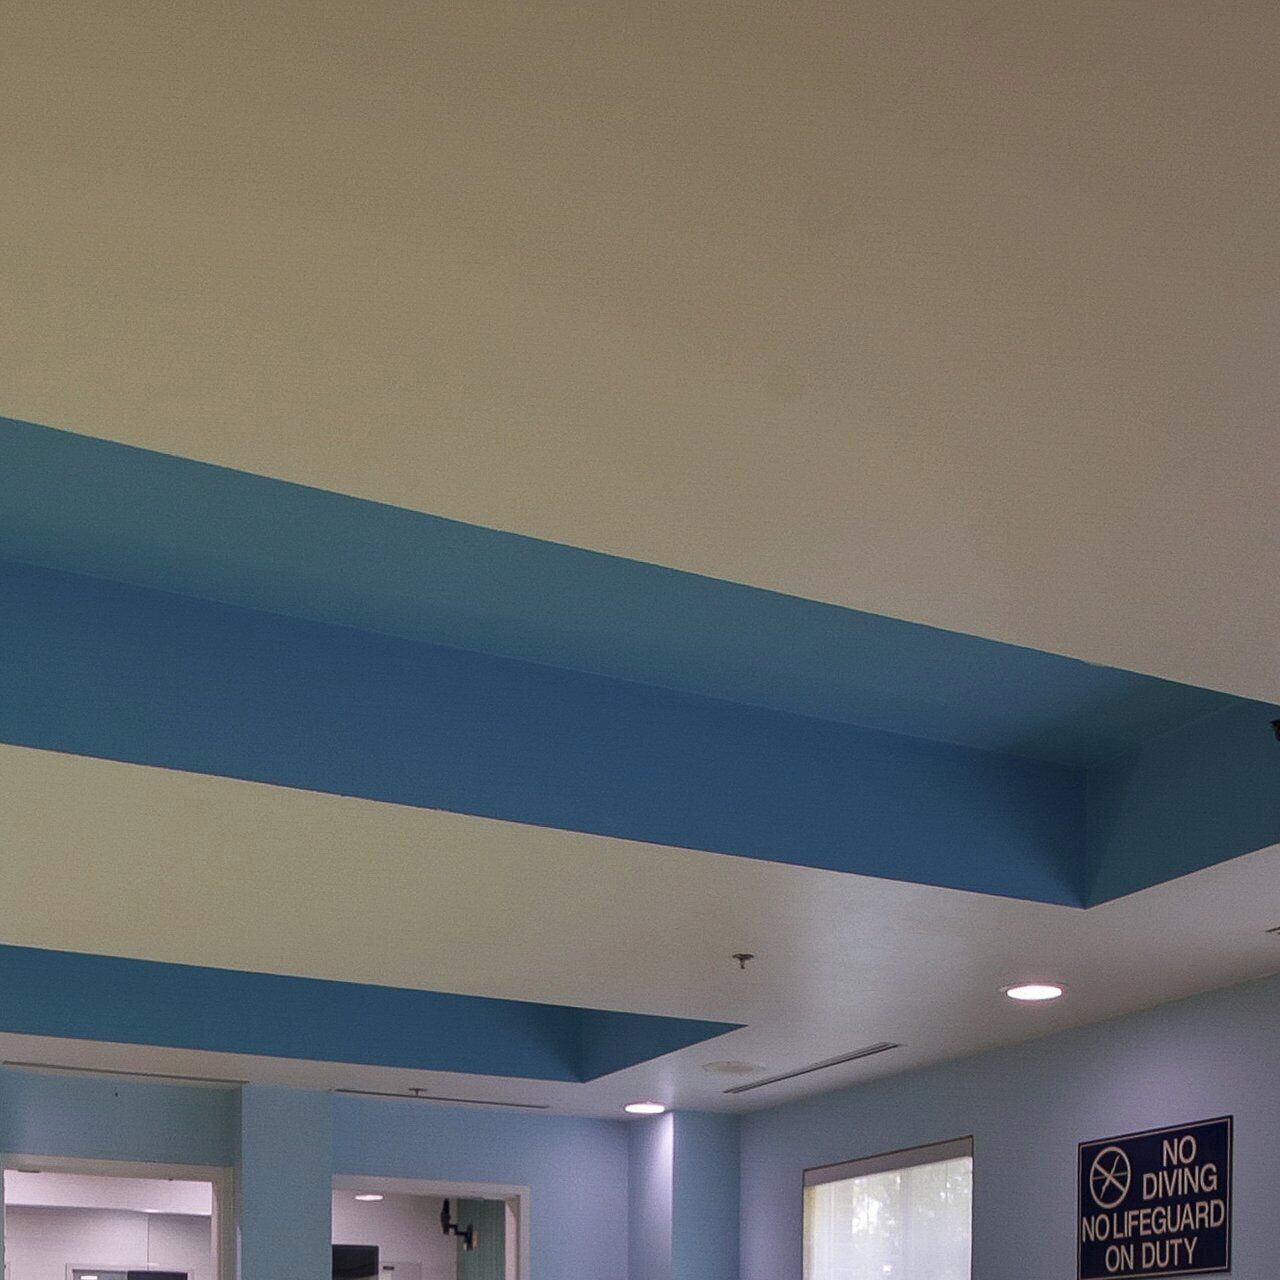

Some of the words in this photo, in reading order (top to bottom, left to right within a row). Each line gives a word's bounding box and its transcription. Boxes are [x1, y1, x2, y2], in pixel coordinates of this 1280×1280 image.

[1162, 1135, 1197, 1167] NO
[1143, 1163, 1218, 1200] DIVING
[1082, 1214, 1110, 1242] NO
[1113, 1200, 1225, 1239] LIFEGUARD
[1105, 1244, 1134, 1272] ON
[1142, 1237, 1198, 1269] DUTY
